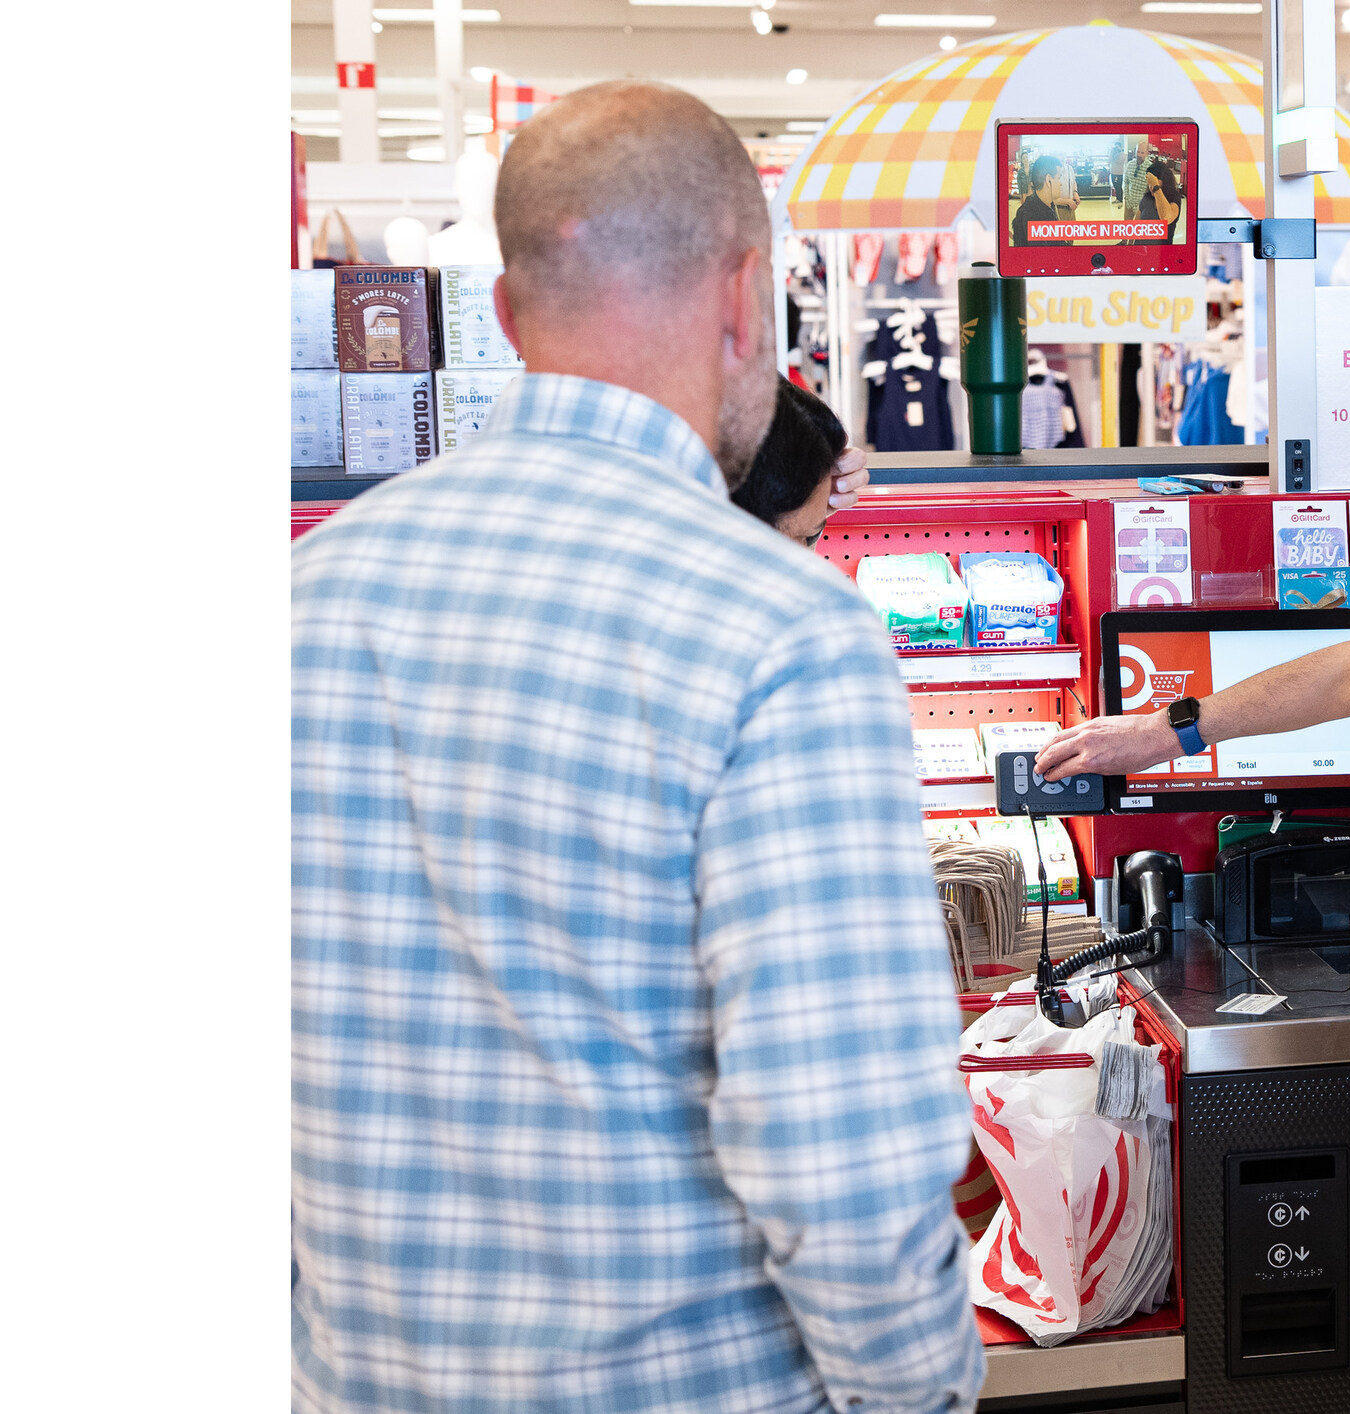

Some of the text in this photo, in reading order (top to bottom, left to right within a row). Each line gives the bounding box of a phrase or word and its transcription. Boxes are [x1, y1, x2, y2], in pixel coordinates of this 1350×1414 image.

[1031, 223, 1165, 237] MONITORING IN PROGRESS
[356, 272, 417, 285] COLOMBE
[351, 289, 385, 306] S'MORES
[387, 290, 411, 306] LATTE
[461, 288, 493, 296] COLOMB
[446, 270, 464, 364] DRAFT LATTE
[1026, 290, 1195, 333] Sun Shop
[346, 376, 361, 421] DRAFT
[441, 378, 456, 425] DRAFT
[456, 395, 493, 404] COLOMBE
[1332, 409, 1348, 422] 10
[348, 427, 365, 469] LATTE
[1300, 514, 1330, 522] GiftCard
[1292, 529, 1335, 545] hello
[1286, 545, 1340, 566] BABY
[1333, 571, 1346, 579] $25
[1037, 605, 1051, 613] 50
[971, 664, 992, 672] 4.29
[1237, 761, 1257, 769] Total
[1313, 759, 1335, 767] $0.00
